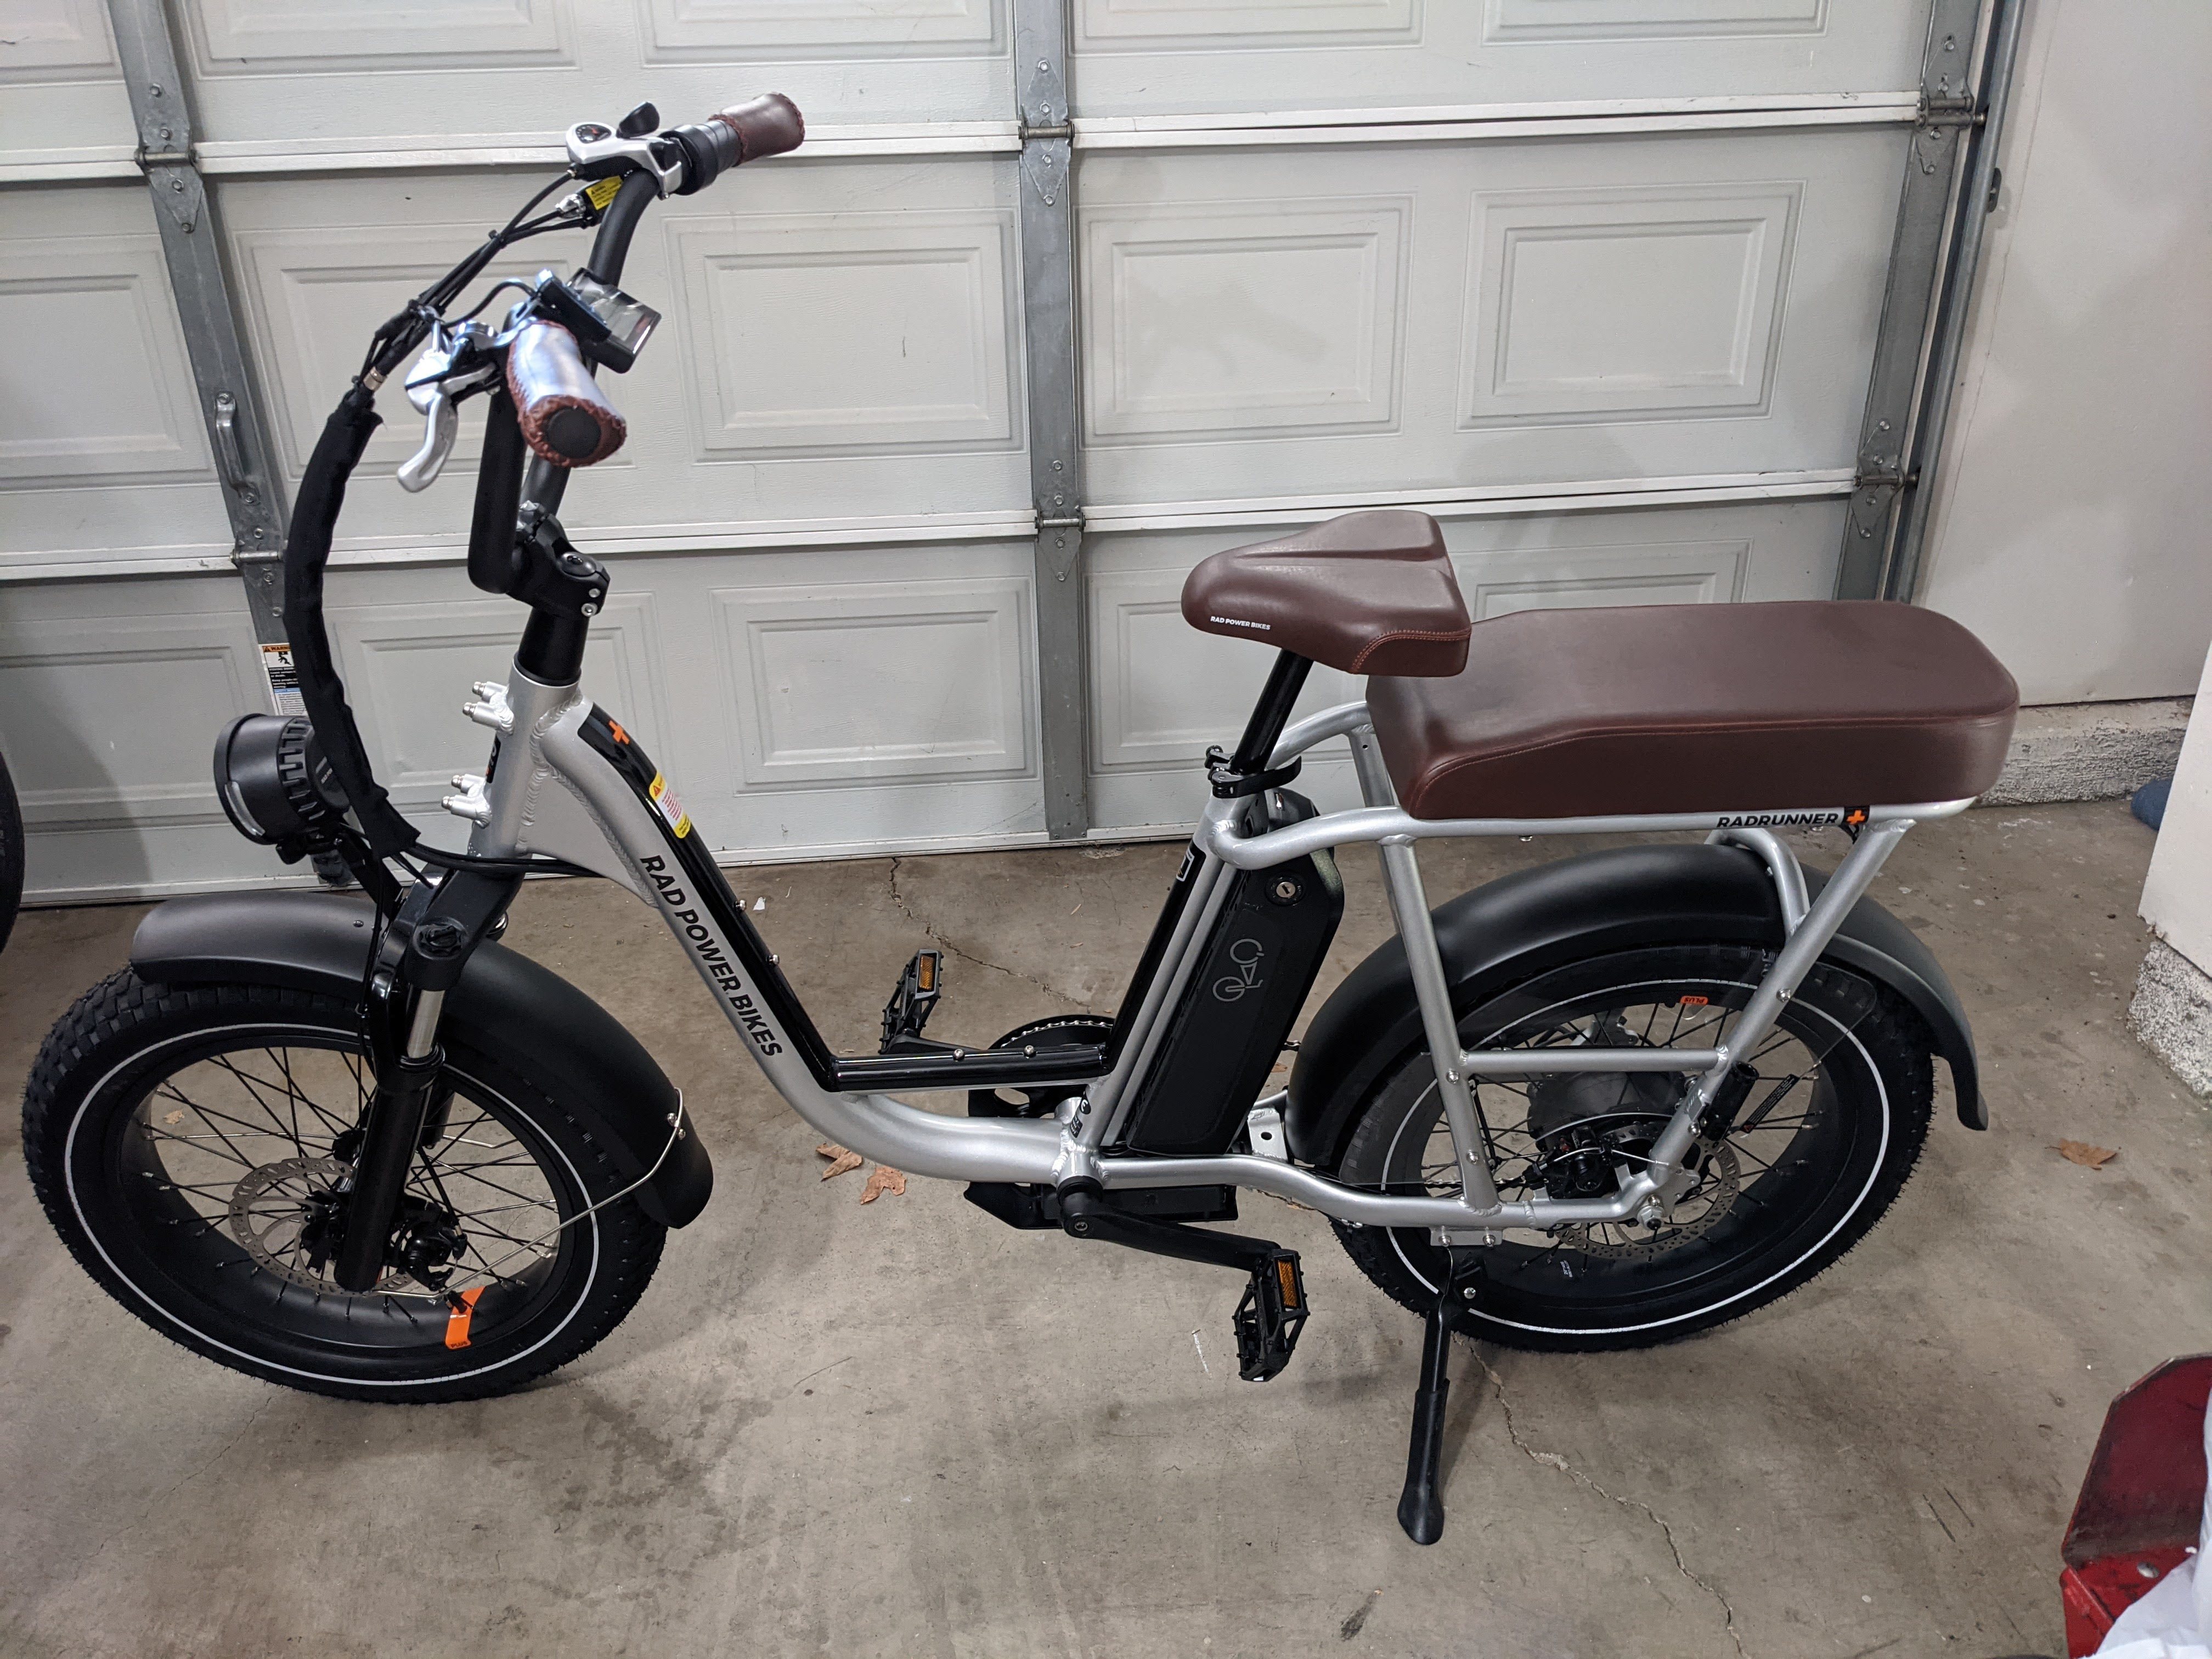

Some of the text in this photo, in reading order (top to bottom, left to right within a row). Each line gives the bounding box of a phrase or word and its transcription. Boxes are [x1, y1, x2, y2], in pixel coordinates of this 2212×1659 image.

[1251, 622, 1271, 630] BIKES
[1717, 813, 1838, 827] RADRUNNER
[640, 855, 685, 906] RAD
[675, 910, 741, 991] POWER
[730, 993, 782, 1056] BIKES
